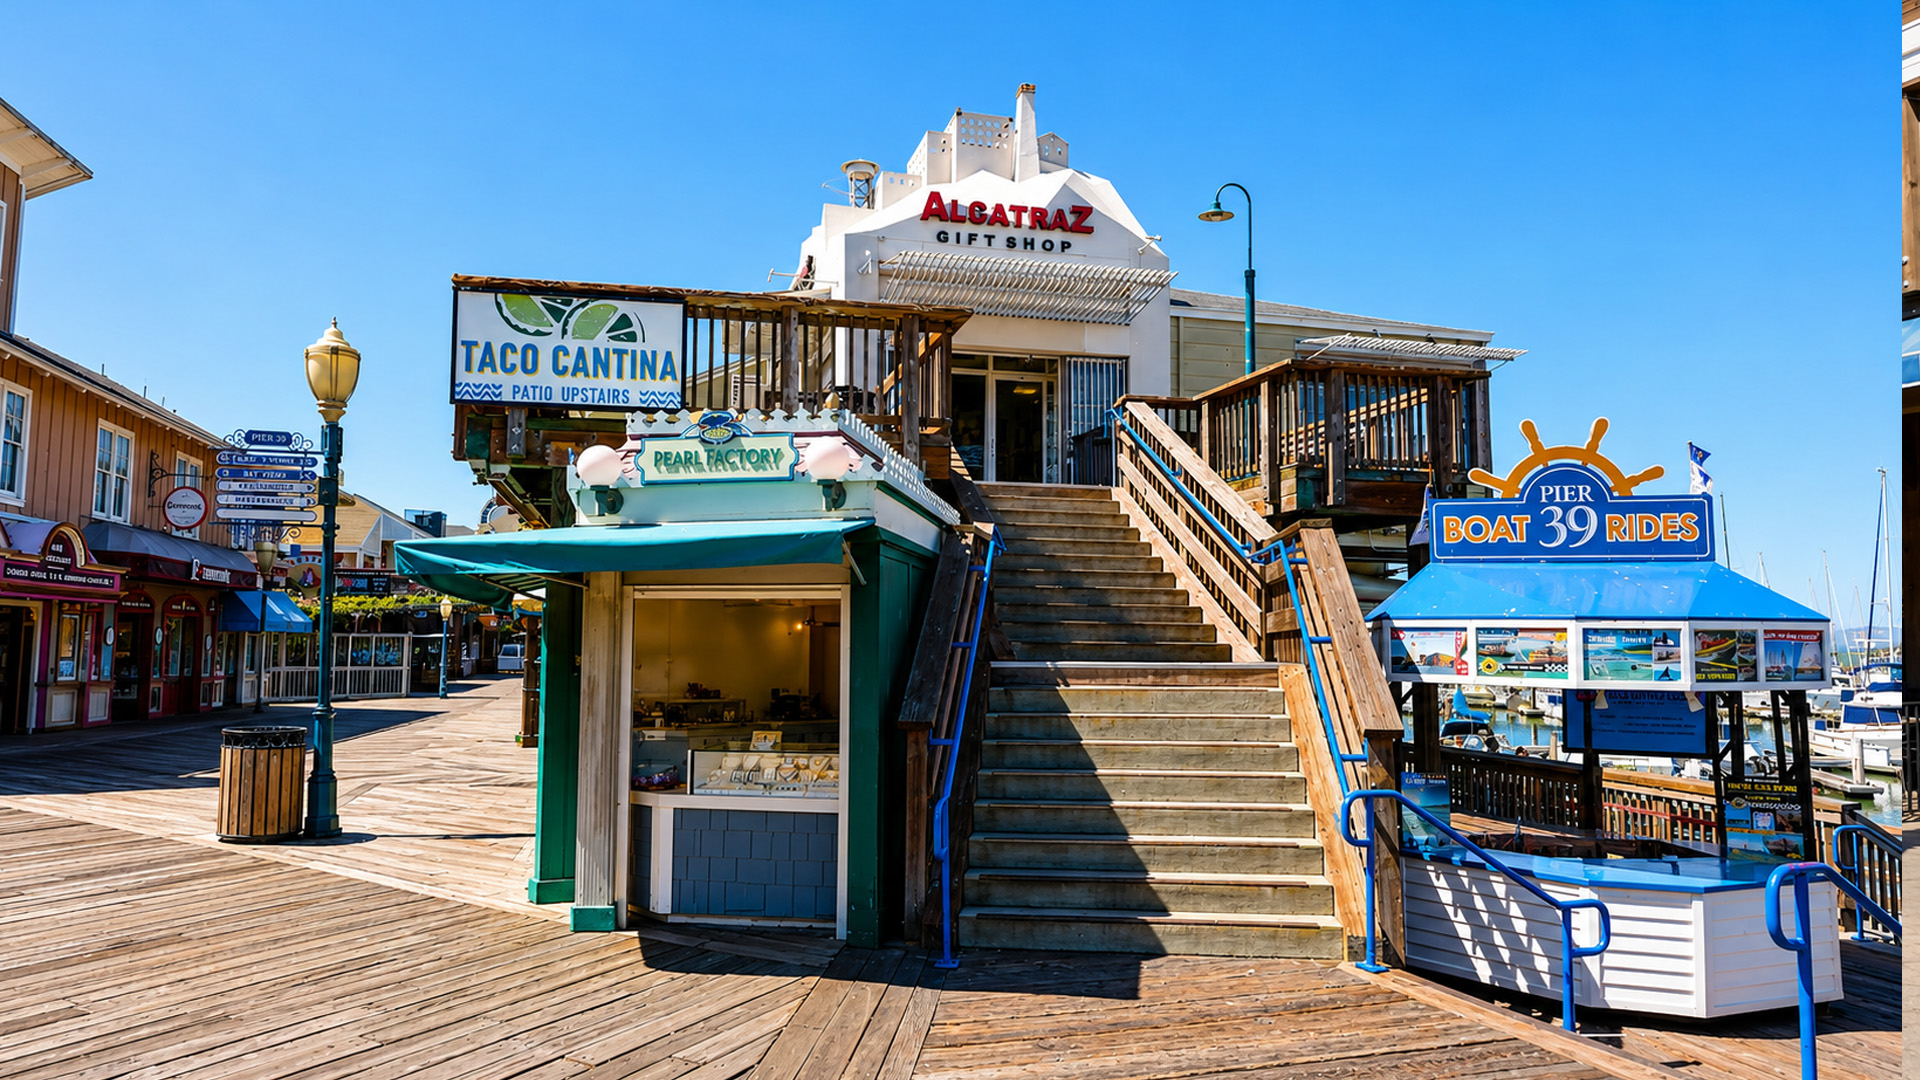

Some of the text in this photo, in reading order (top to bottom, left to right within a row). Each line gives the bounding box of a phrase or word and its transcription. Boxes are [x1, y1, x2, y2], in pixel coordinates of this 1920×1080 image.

[920, 191, 1094, 234] ALCATRAZ
[936, 230, 1072, 253] GIFT SHOP
[460, 339, 679, 382] TACO CANTINA
[512, 384, 630, 405] PATIO UPSTAIRS
[251, 433, 274, 442] PIER
[653, 447, 783, 468] PEARL FACTORY
[1539, 484, 1595, 503] PIER
[1443, 505, 1700, 548] BOAT 39 RIDES
